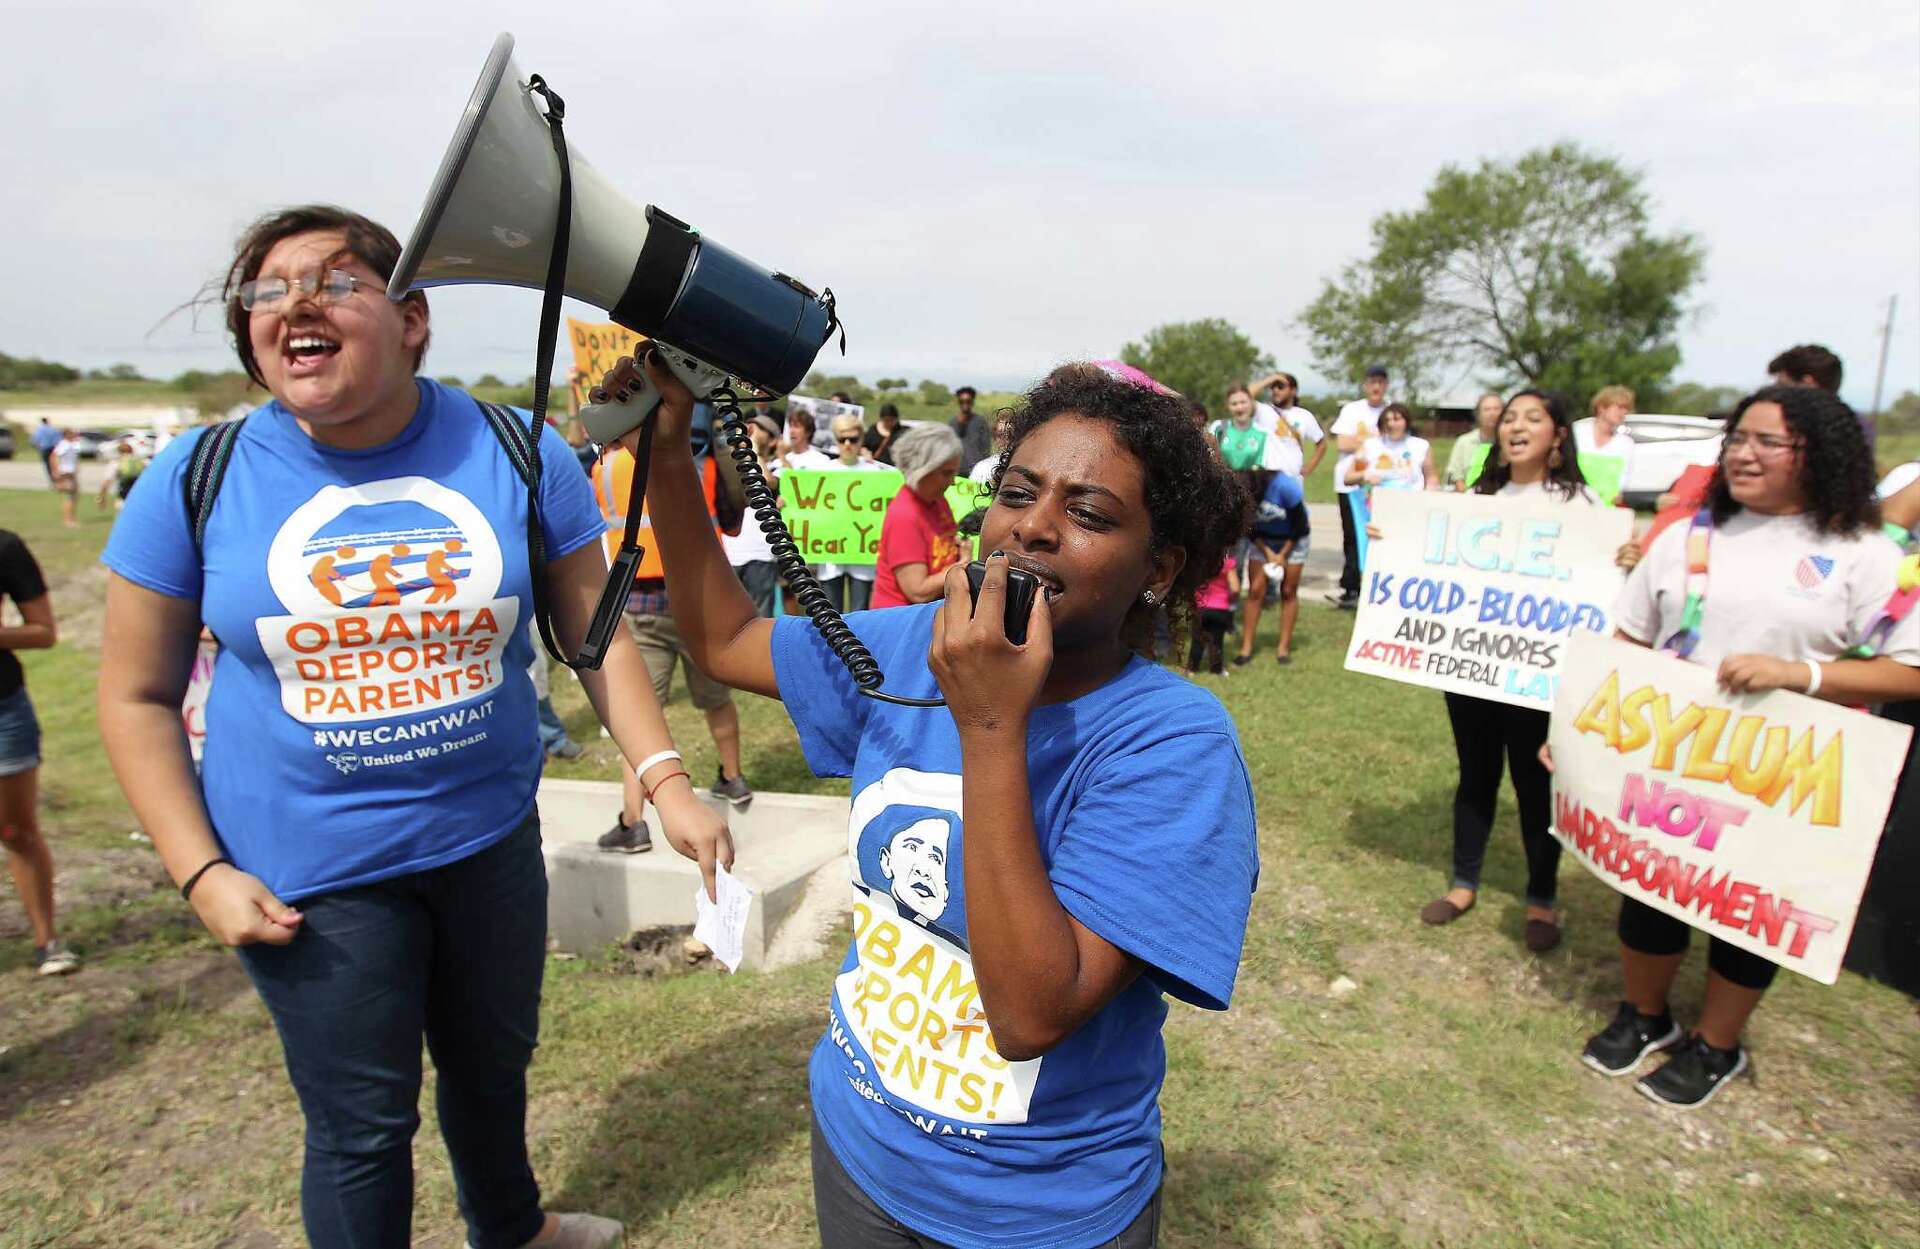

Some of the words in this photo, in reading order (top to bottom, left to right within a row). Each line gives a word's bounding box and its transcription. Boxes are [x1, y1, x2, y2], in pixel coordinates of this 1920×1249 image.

[789, 476, 836, 511] We
[789, 519, 848, 555] Hear
[853, 521, 881, 554] Yo
[1423, 507, 1572, 581] I.C.E.
[1368, 571, 1394, 605] IS
[286, 607, 498, 653] OBAMA
[1395, 616, 1446, 645] AND
[1450, 627, 1560, 669] IGNORES
[295, 638, 493, 681] DEPORTS
[1355, 639, 1424, 671] ACTIVE
[1426, 652, 1501, 687] FEDERAL
[304, 660, 494, 715] PARENTS!
[361, 749, 413, 767] United
[414, 745, 439, 759] We
[441, 731, 488, 753] Dream
[1572, 668, 1844, 828] ASYLUM
[1618, 772, 1752, 852] NOT
[1556, 790, 1841, 959] IMPRISONMENT
